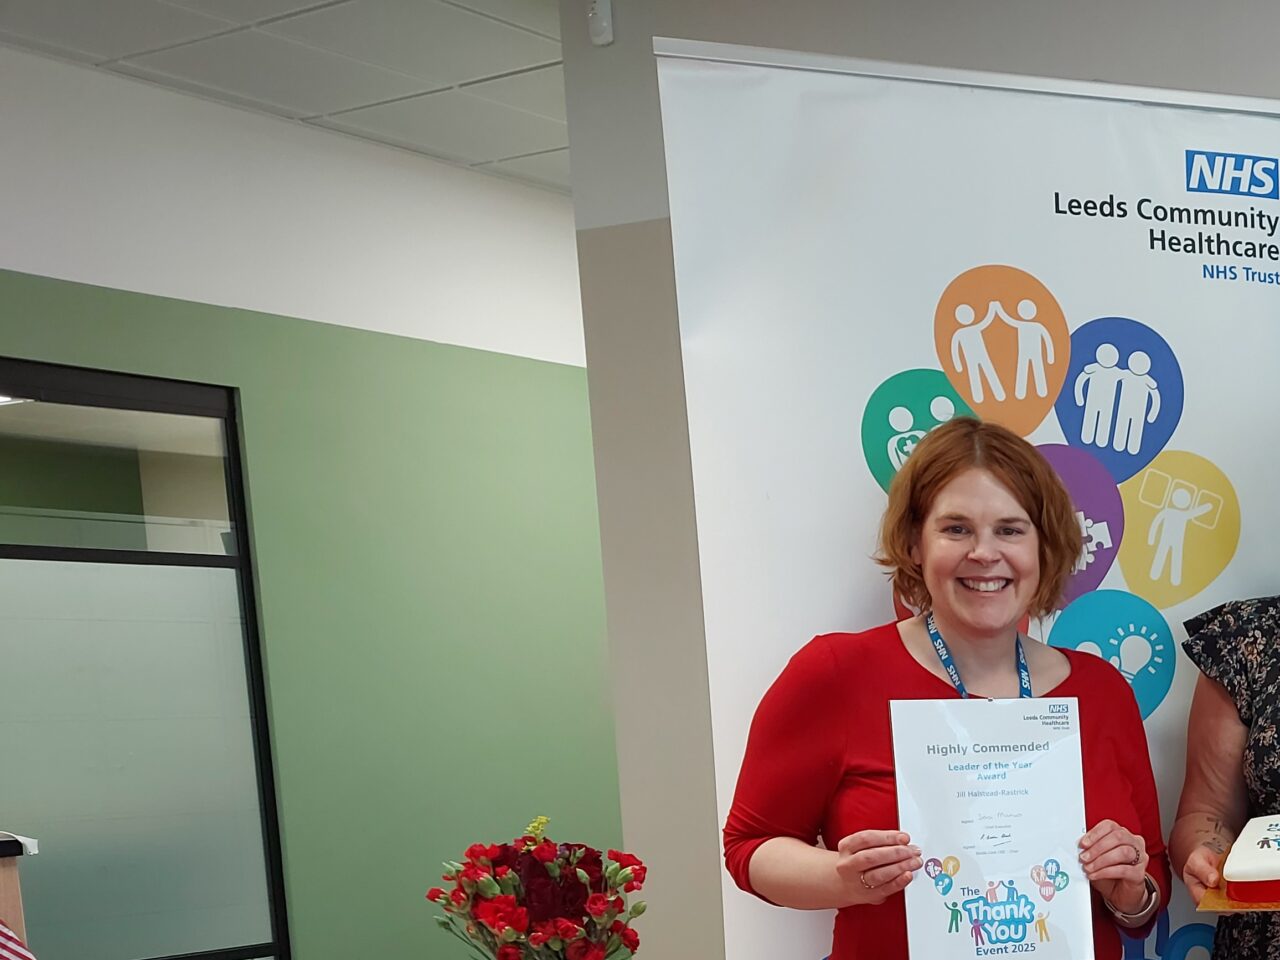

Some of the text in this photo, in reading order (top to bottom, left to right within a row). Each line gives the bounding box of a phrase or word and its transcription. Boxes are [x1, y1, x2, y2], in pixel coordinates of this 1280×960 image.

[1187, 153, 1277, 195] NHS
[1053, 191, 1280, 237] Leeds Community
[1149, 228, 1280, 261] Healthcare
[1202, 264, 1280, 286] NHS Trust
[934, 639, 949, 660] NHS
[947, 665, 960, 686] NHS
[1049, 704, 1068, 713] NHS
[927, 741, 1050, 756] Highly Commended
[948, 761, 1033, 771] Leader of the Year
[977, 771, 1006, 780] Award
[960, 887, 980, 896] The
[966, 898, 1032, 920] Thank
[976, 942, 1036, 956] Event 2025
